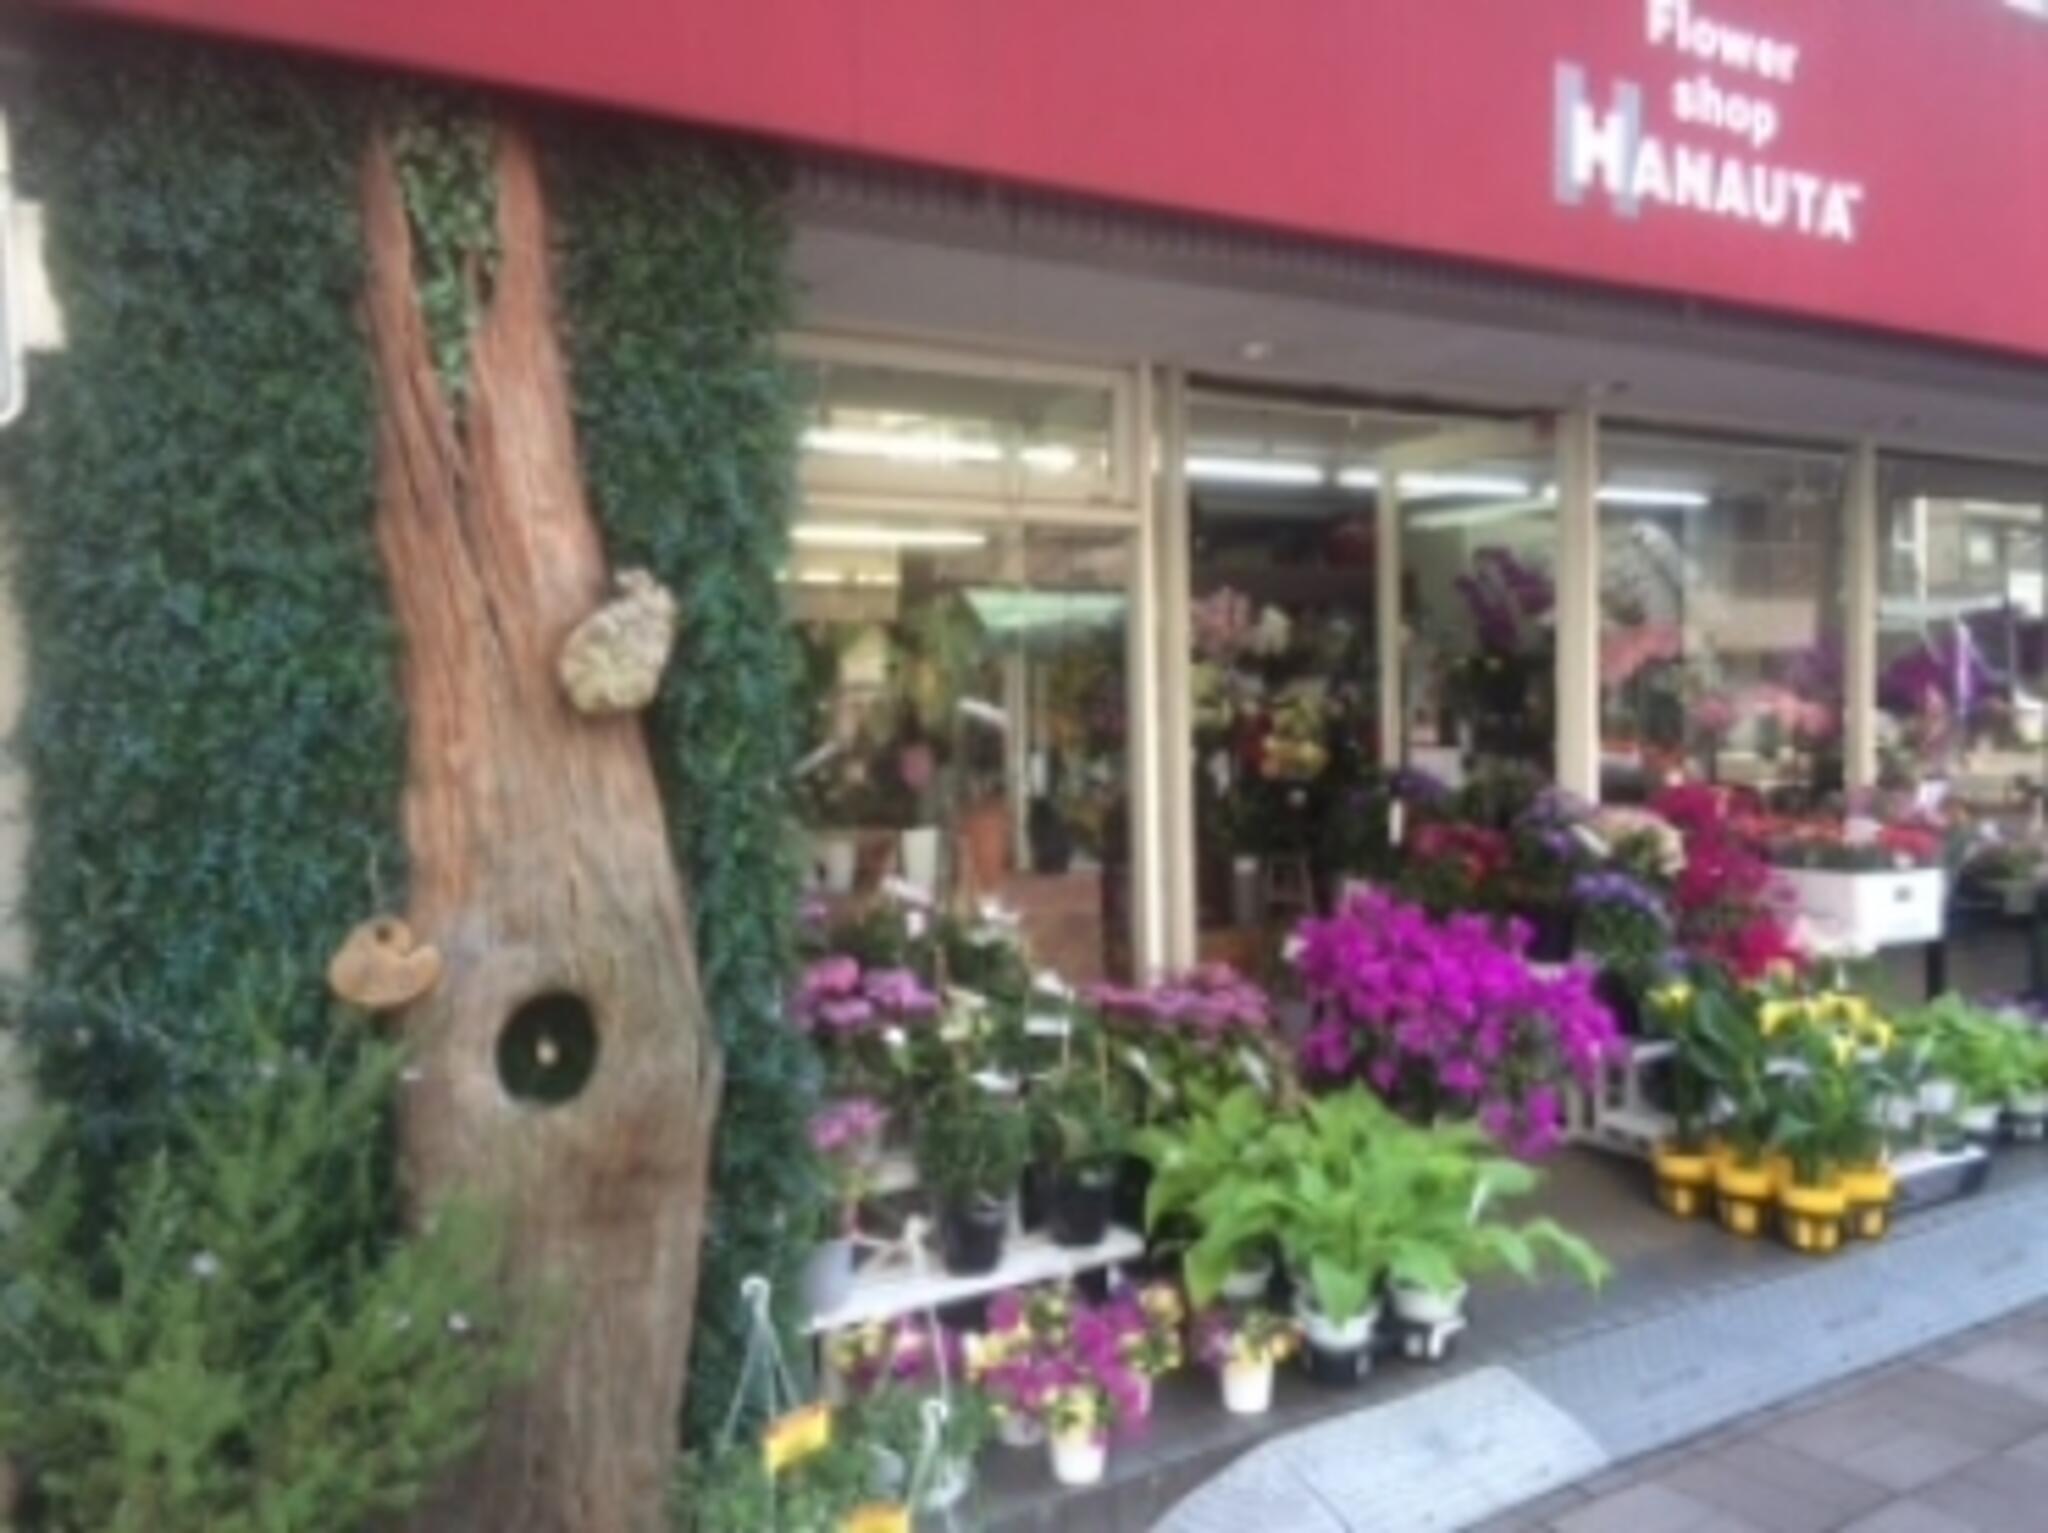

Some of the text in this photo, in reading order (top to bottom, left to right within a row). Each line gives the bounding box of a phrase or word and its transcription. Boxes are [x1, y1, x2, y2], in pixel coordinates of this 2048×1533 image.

[1646, 0, 1798, 84] Flower
[1672, 75, 1778, 148] shop
[1566, 98, 1864, 243] HANAUTA
